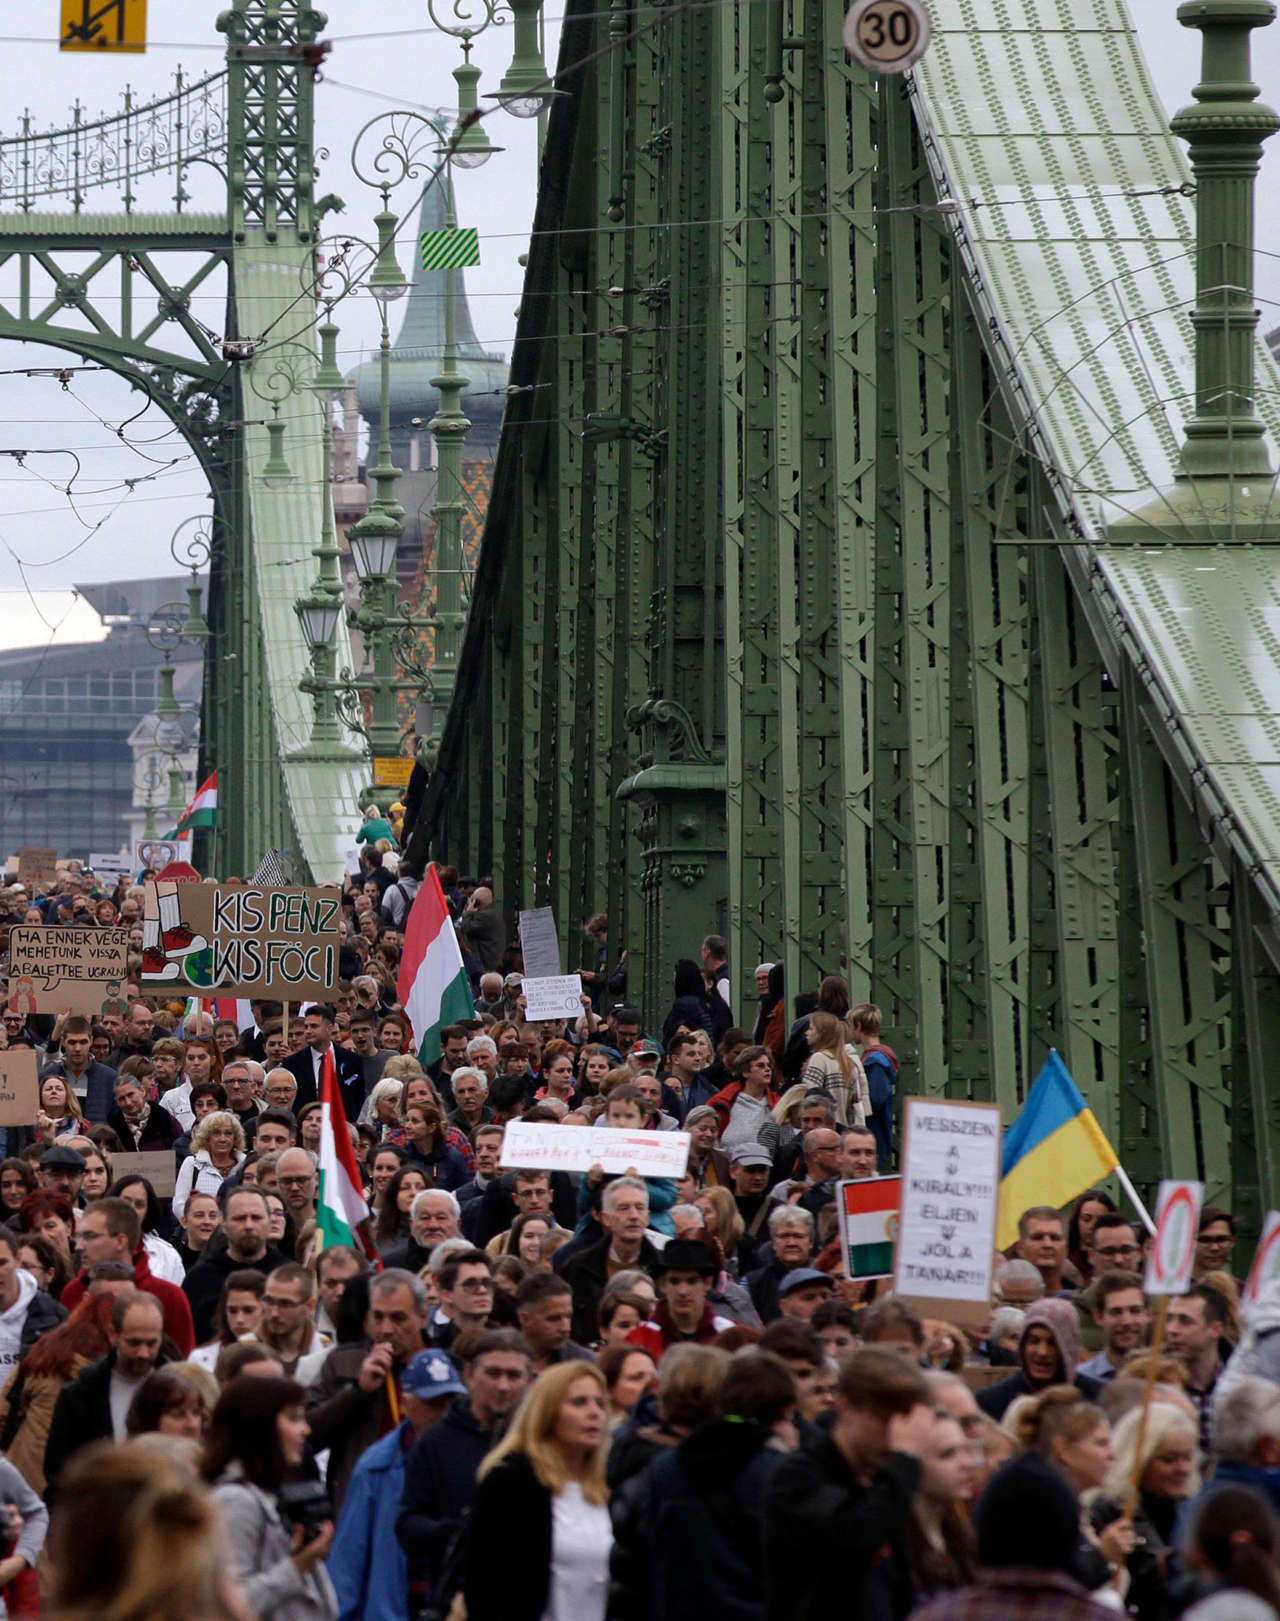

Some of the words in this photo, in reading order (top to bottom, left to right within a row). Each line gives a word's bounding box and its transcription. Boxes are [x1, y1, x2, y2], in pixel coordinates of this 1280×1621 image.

[864, 11, 911, 48] 30
[213, 890, 264, 933] KIS
[18, 930, 41, 943] HA
[46, 930, 93, 945] ENNEK
[89, 948, 122, 961] VISSZA
[213, 939, 263, 985] KIS
